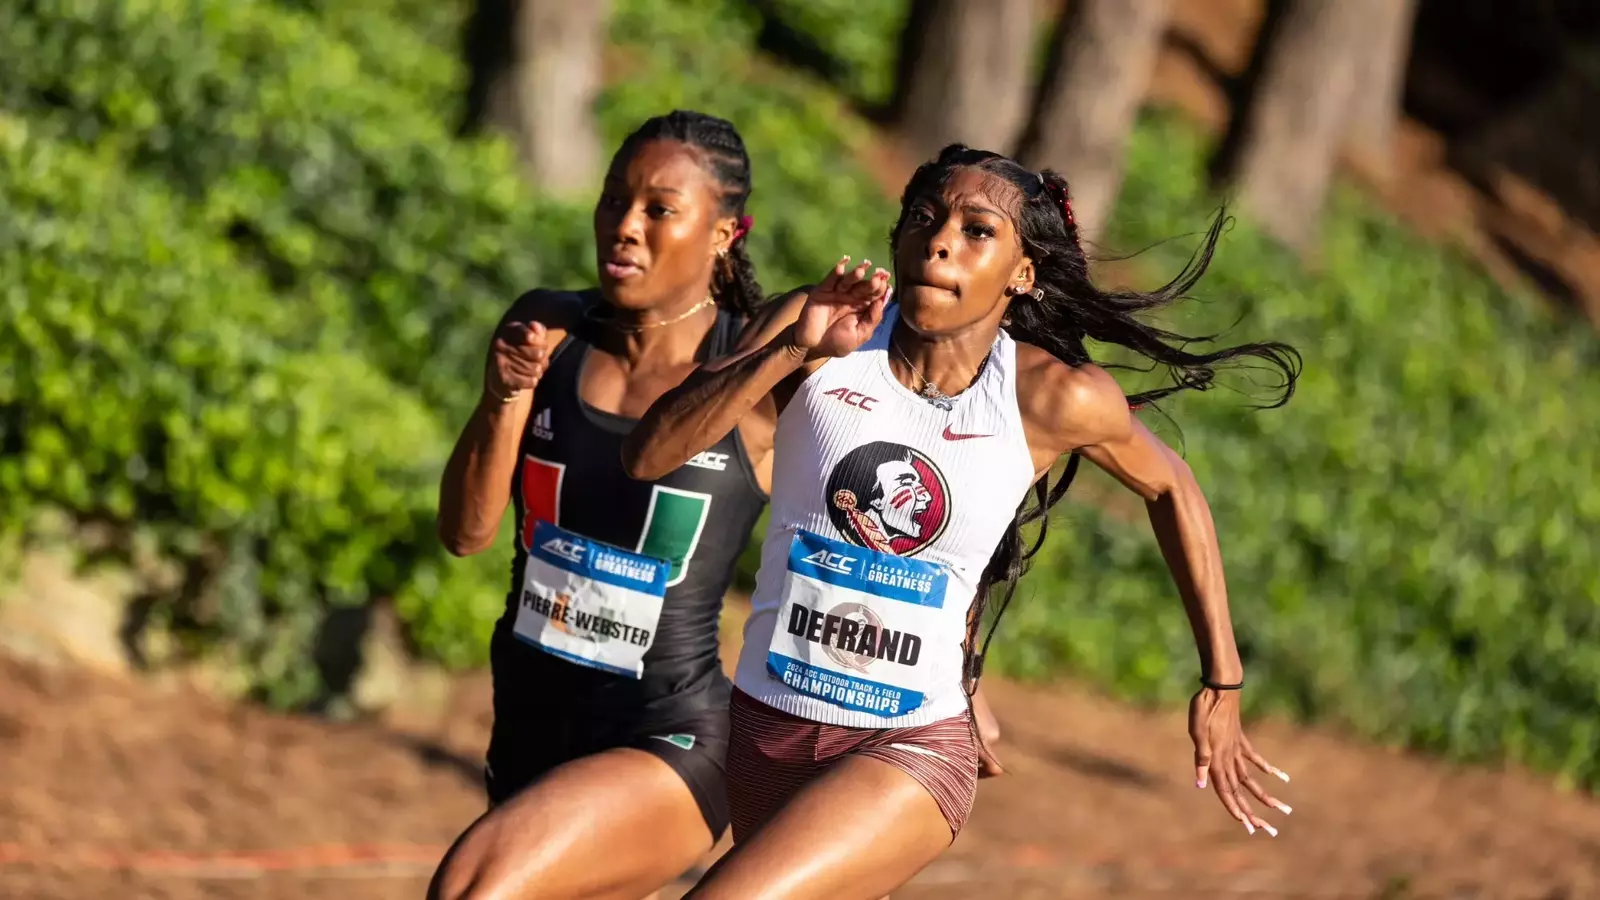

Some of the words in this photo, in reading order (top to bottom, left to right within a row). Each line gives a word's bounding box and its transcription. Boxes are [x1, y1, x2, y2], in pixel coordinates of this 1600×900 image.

[823, 387, 879, 411] ACC
[685, 451, 729, 471] ACC
[540, 538, 587, 562] ACC
[800, 549, 857, 574] ACC
[594, 558, 655, 583] GREATNESS
[868, 570, 932, 593] GREATNESS
[870, 563, 934, 581] ACCOMPLISH
[523, 590, 650, 648] PIERRE-WEBSTER
[788, 603, 922, 666] DEFRAND
[783, 670, 900, 714] CHAMPIONSHIPS
[786, 662, 803, 673] 2024
[804, 669, 818, 679] ACC
[819, 672, 849, 687] OUTDOOR
[851, 681, 874, 693] TRACK
[875, 687, 881, 695] &
[882, 689, 901, 700] FIELD
